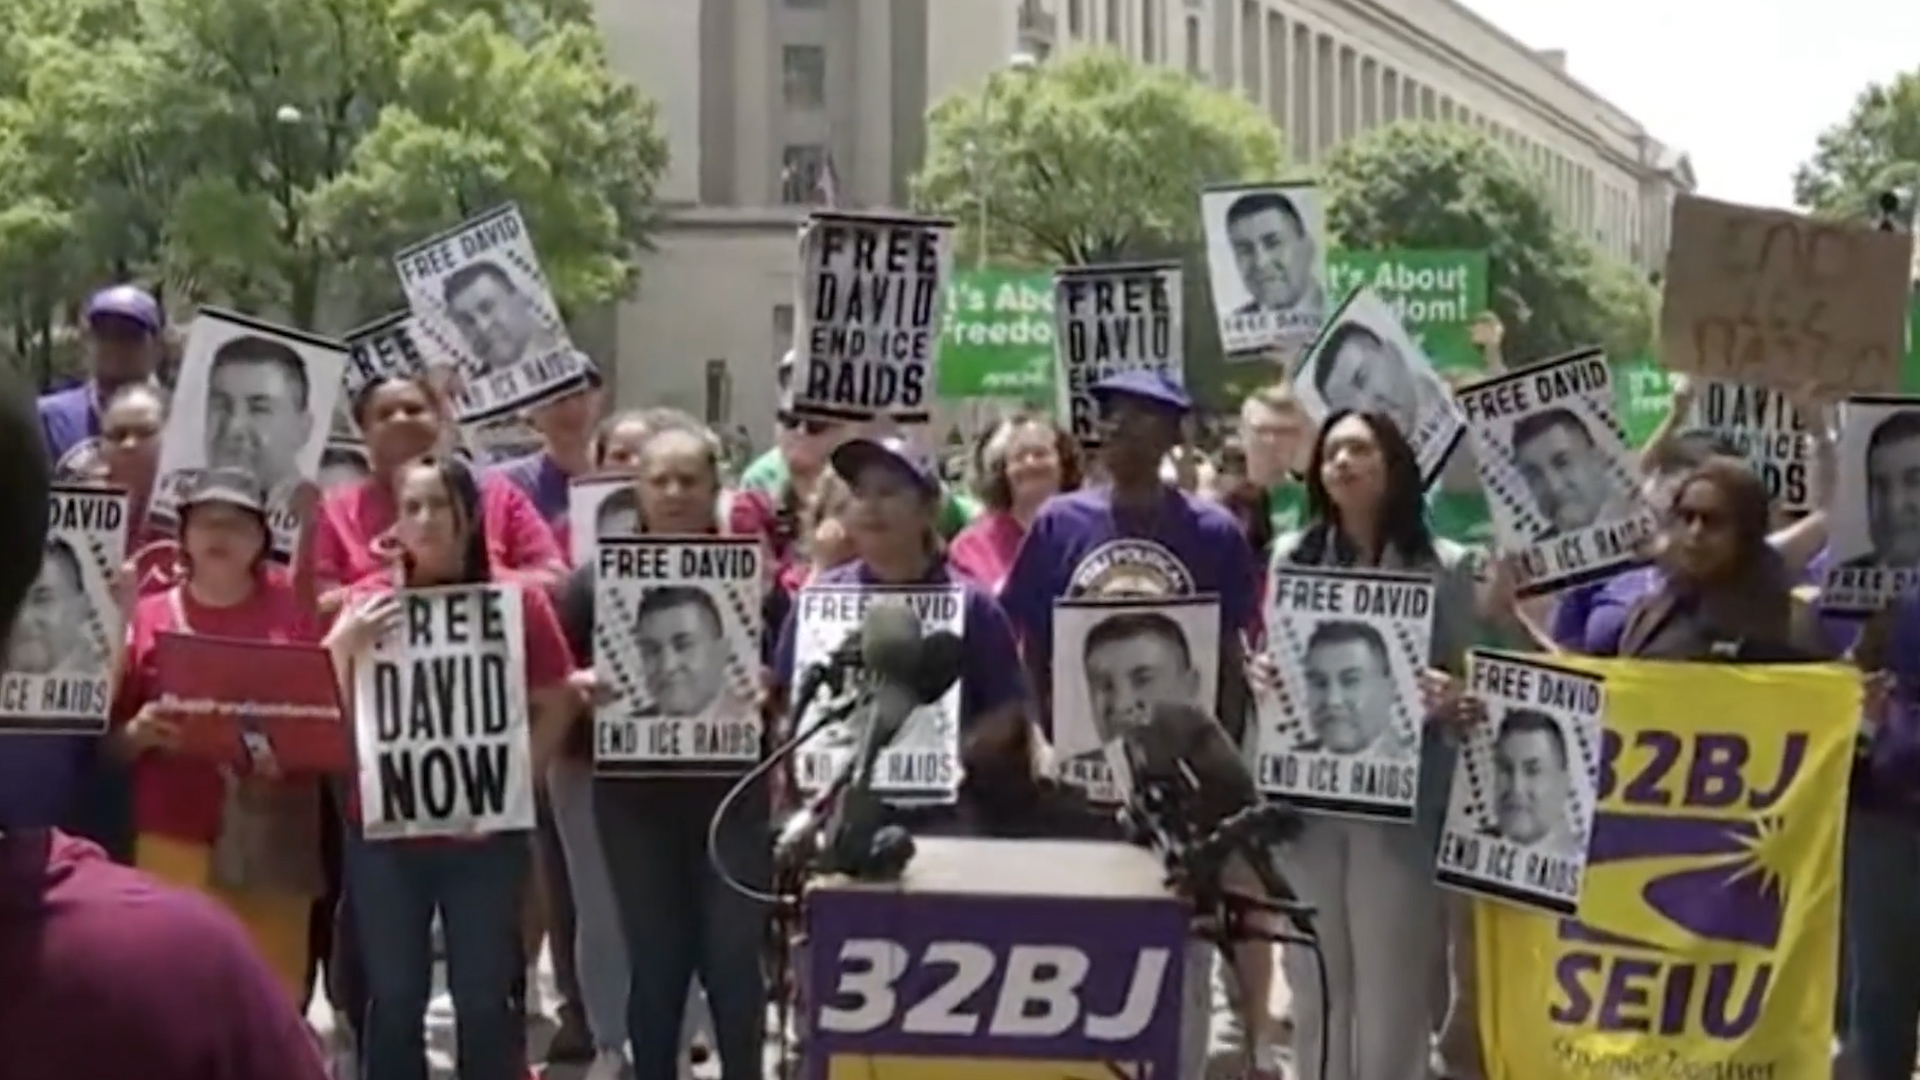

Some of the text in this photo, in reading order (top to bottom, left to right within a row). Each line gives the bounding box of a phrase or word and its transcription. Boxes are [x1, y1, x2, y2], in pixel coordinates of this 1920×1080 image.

[401, 215, 519, 283] FREE DAVID
[821, 228, 938, 274] FREE
[816, 273, 935, 327] DAVID
[1068, 278, 1169, 314] FREE
[1374, 262, 1468, 291] About
[352, 327, 419, 379] REE
[811, 326, 928, 361] END ICE
[1069, 316, 1169, 363] DAVID
[807, 359, 924, 406] RAIDS
[1463, 381, 1529, 423] FREE
[1535, 360, 1608, 405] DAVID
[602, 548, 756, 579] FREE DAVID
[408, 590, 505, 646] REE
[1275, 578, 1428, 619] FREE DAVID
[42, 679, 108, 714] RAIDS
[374, 654, 508, 743] DAVID
[1472, 661, 1600, 716] FREE DAVID
[600, 721, 757, 755] END ICE RAIDS
[378, 743, 510, 822] NOW
[888, 753, 953, 784] RAIDS
[1259, 754, 1416, 799] END ICE RAIDS
[1442, 831, 1479, 872] END
[1485, 843, 1516, 881] ICE
[817, 937, 1172, 1043] 32BJ
[1548, 951, 1774, 1040] SEIU
